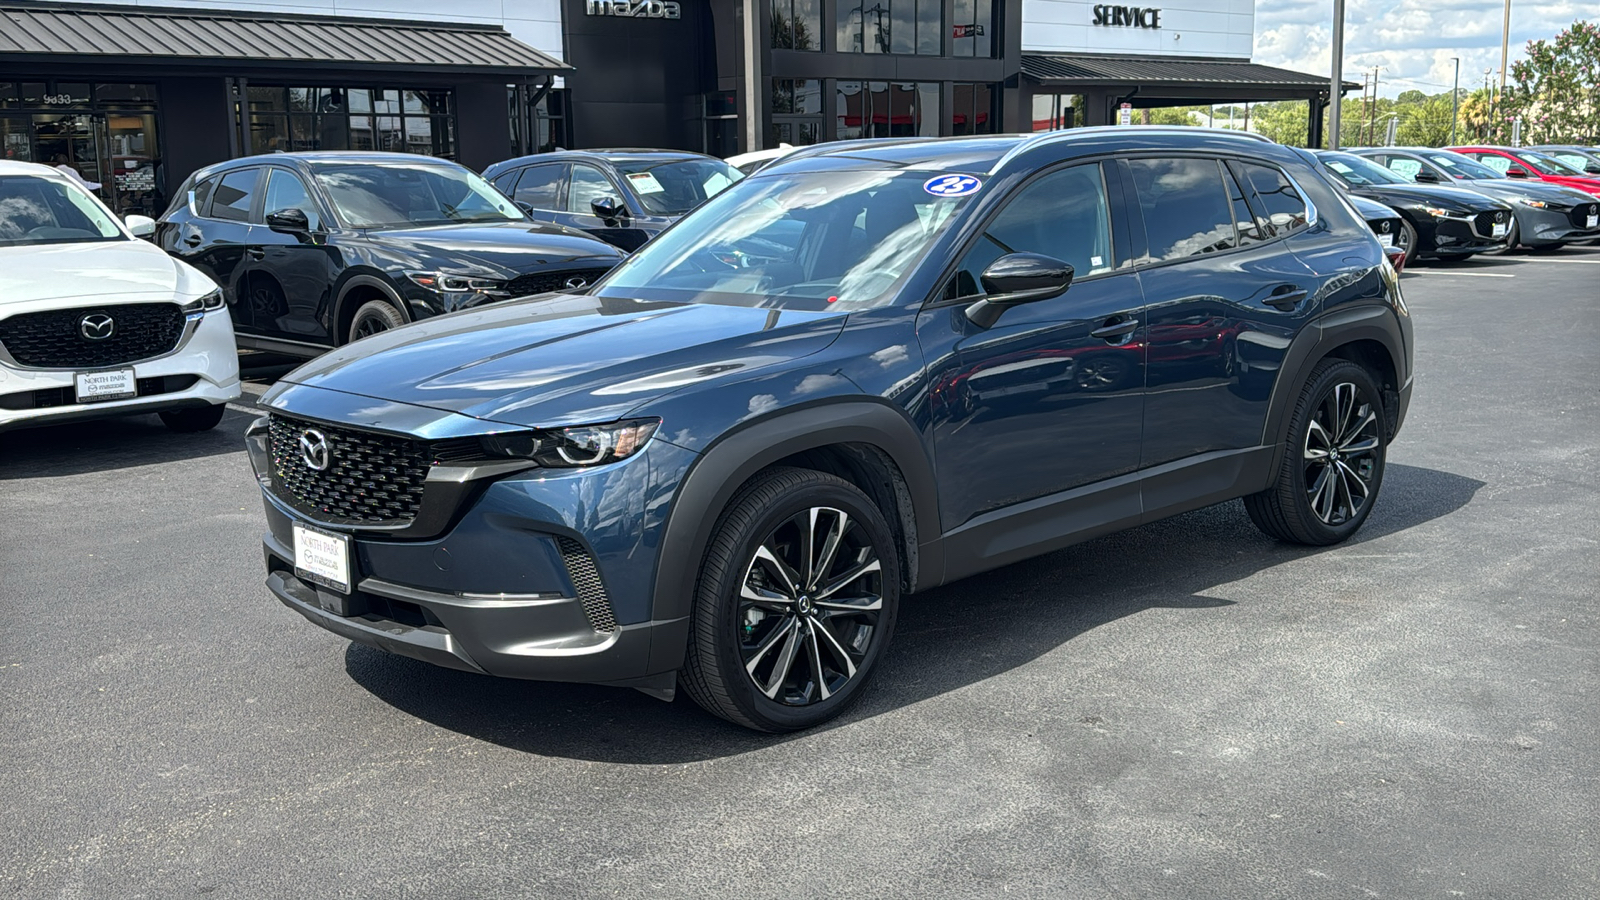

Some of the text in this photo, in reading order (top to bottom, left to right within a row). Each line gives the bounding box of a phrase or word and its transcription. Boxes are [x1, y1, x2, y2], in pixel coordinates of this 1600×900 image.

[586, 0, 681, 19] mazda
[1092, 4, 1162, 29] SERVICE
[930, 177, 975, 193] 25
[84, 376, 109, 384] NORTH
[301, 535, 339, 556] NORTH PARK
